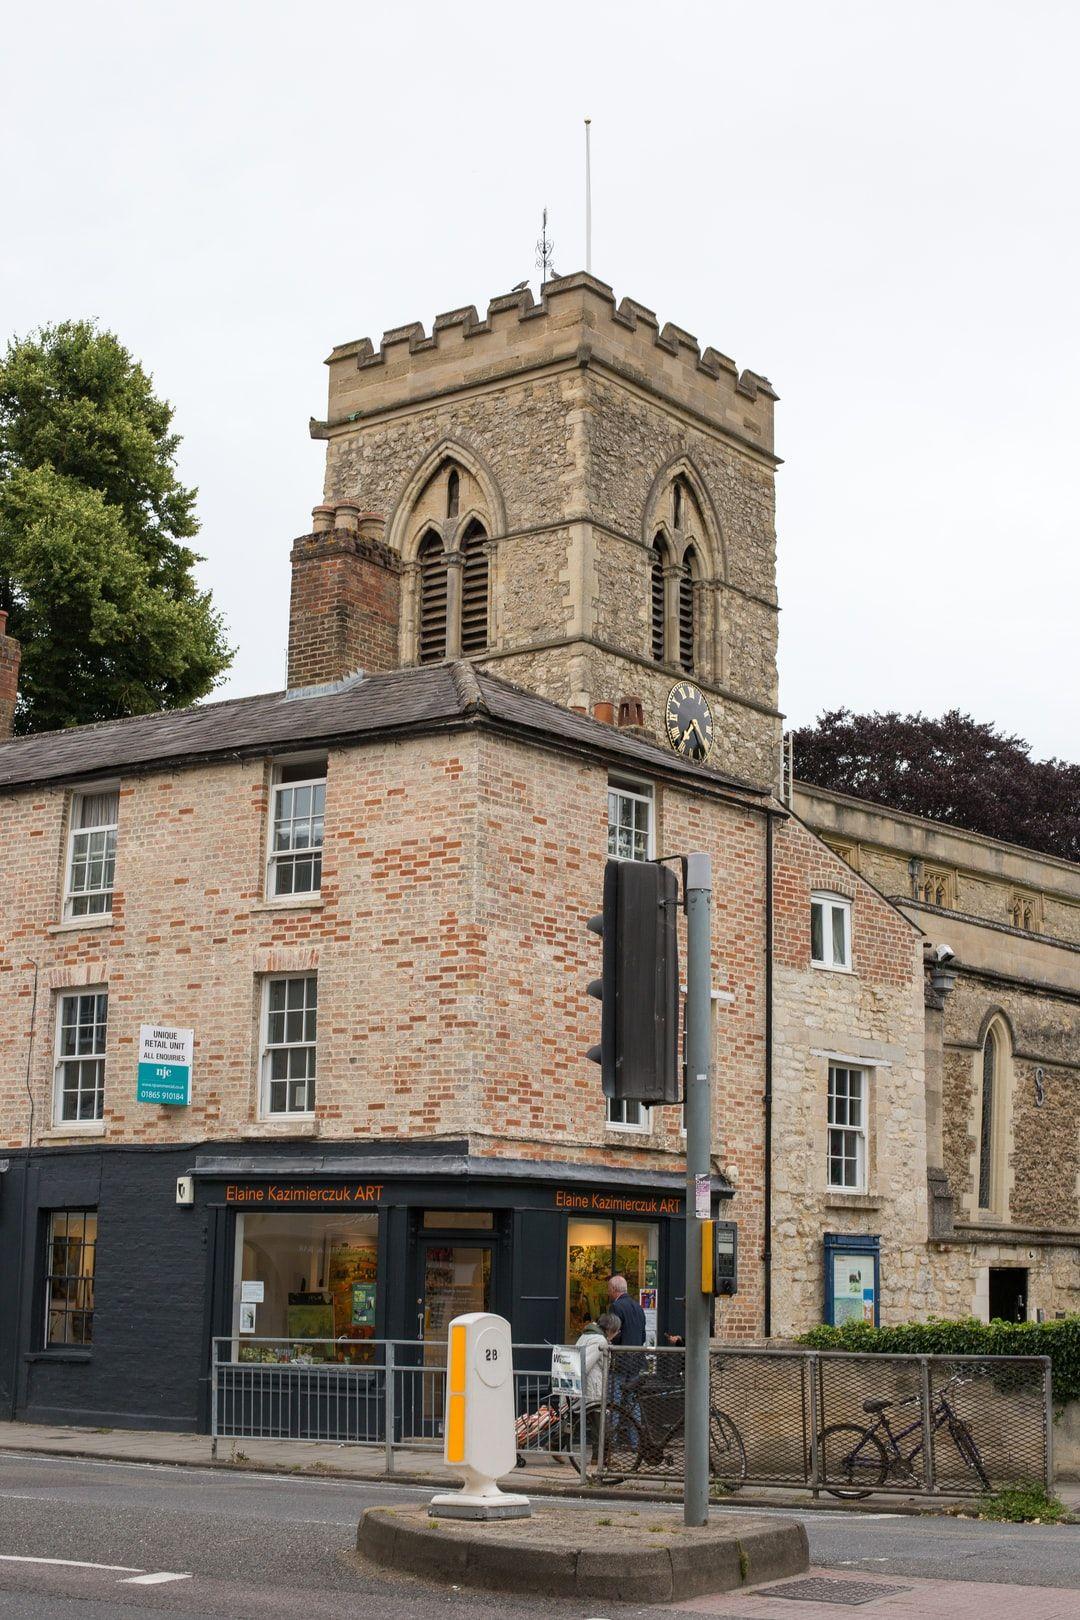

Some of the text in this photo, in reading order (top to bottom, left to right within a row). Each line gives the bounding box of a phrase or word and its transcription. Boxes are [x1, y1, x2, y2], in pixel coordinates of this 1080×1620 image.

[153, 1030, 177, 1040] UNIQUE
[144, 1039, 185, 1050] RETAIL UNIT
[156, 1052, 185, 1062] ENQUIRIES
[156, 1066, 171, 1079] njc
[141, 1090, 184, 1100] 01865 910184
[226, 1185, 384, 1201] Elaine Kazimierczuk ART
[556, 1191, 589, 1208] Elaine
[591, 1193, 657, 1213] Kazimierczuk
[660, 1199, 681, 1214] ART
[485, 1349, 498, 1361] 2B
